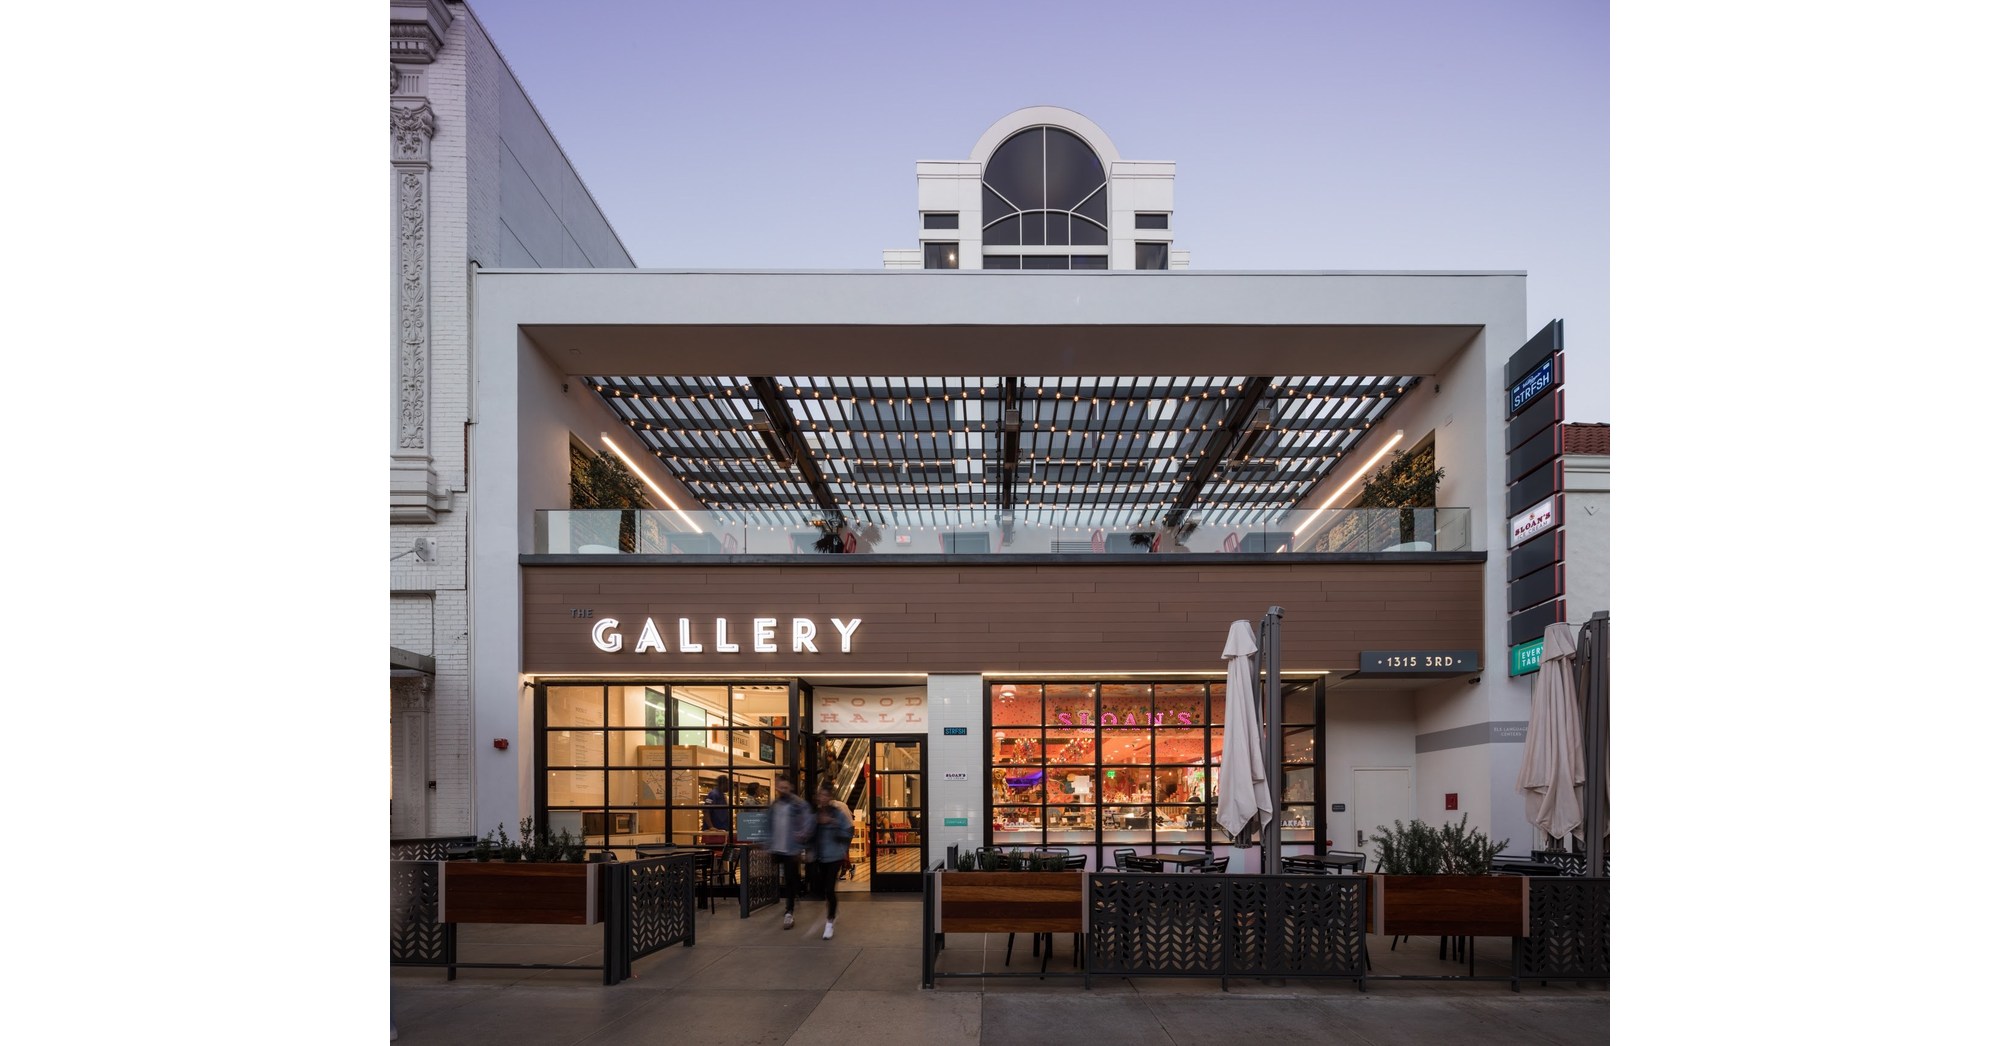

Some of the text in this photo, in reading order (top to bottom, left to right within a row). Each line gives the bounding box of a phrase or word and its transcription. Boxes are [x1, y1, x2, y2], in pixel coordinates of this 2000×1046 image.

[1514, 372, 1550, 407] STRFSH
[1515, 511, 1551, 536] SLOAN'S
[570, 608, 594, 619] THE
[591, 616, 863, 653] GALLERY
[1387, 656, 1453, 667] 1315 3RD
[821, 697, 923, 707] FOOD
[820, 713, 922, 723] HALL
[1058, 710, 1192, 731] SLOAN'S
